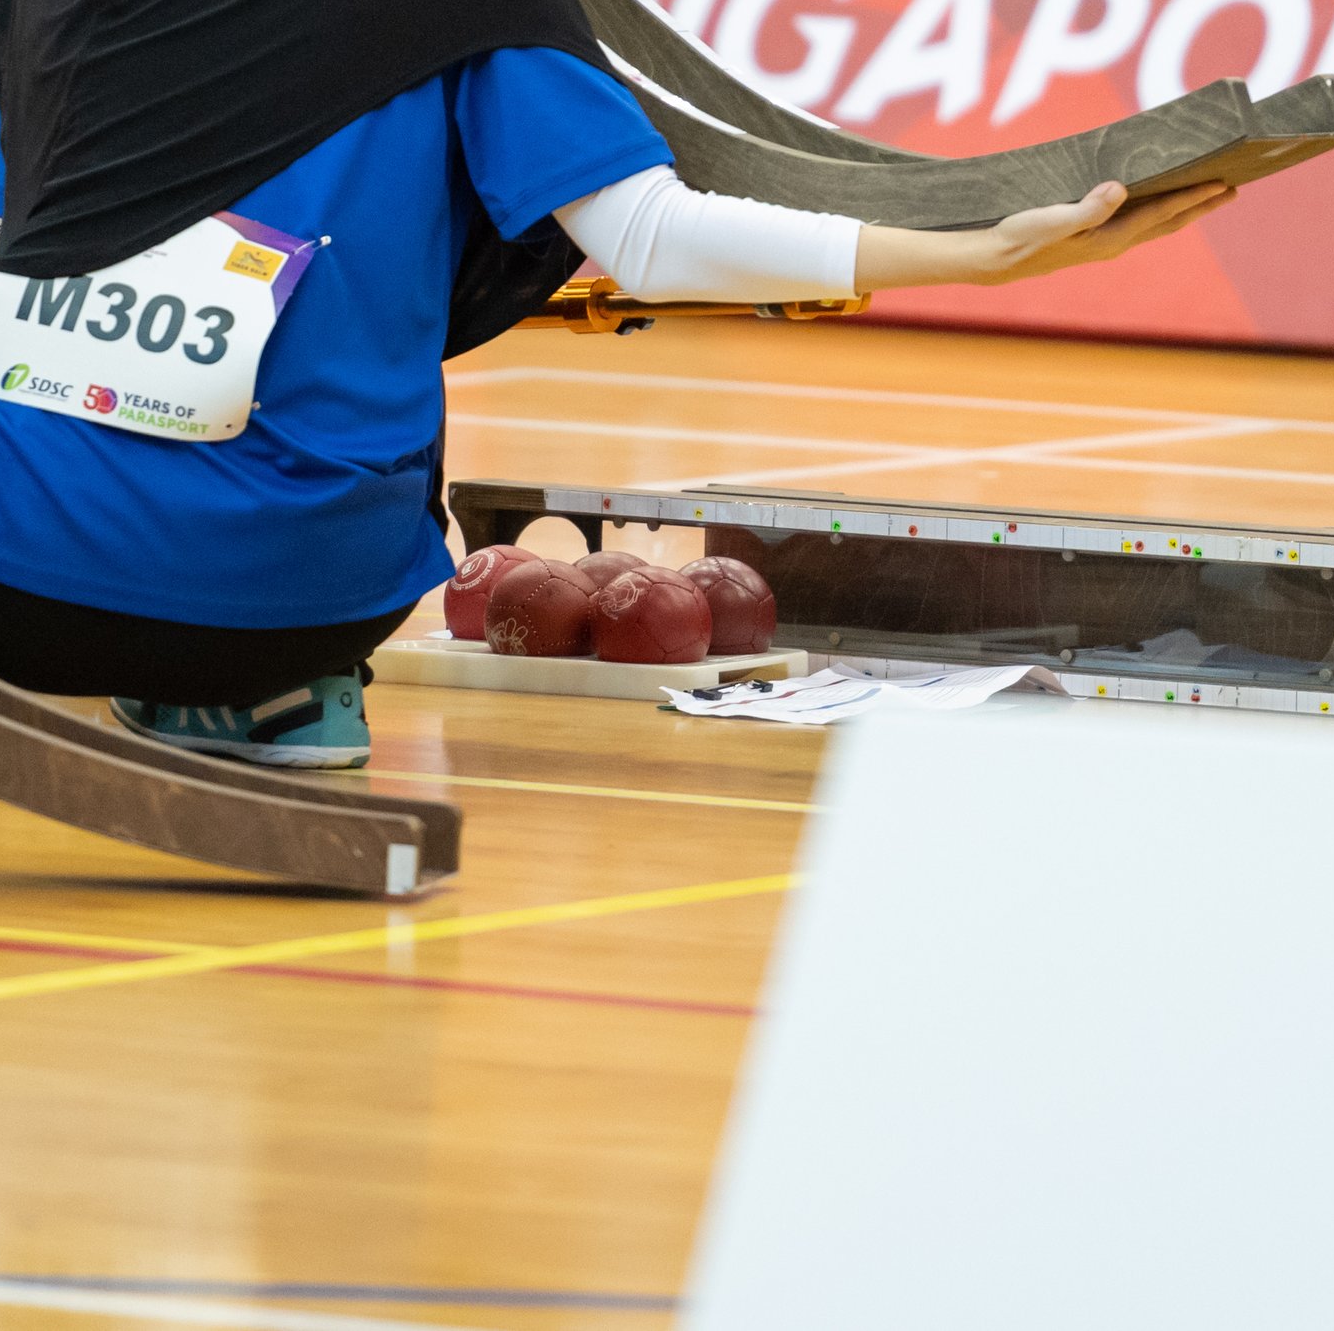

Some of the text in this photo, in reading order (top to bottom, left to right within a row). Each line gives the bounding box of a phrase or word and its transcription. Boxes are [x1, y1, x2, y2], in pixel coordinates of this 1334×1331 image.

[15, 274, 235, 365] M303
[28, 376, 74, 398] SDSC
[124, 392, 170, 414] YEARS
[175, 406, 196, 419] OF
[119, 406, 210, 435] PARASPORT
